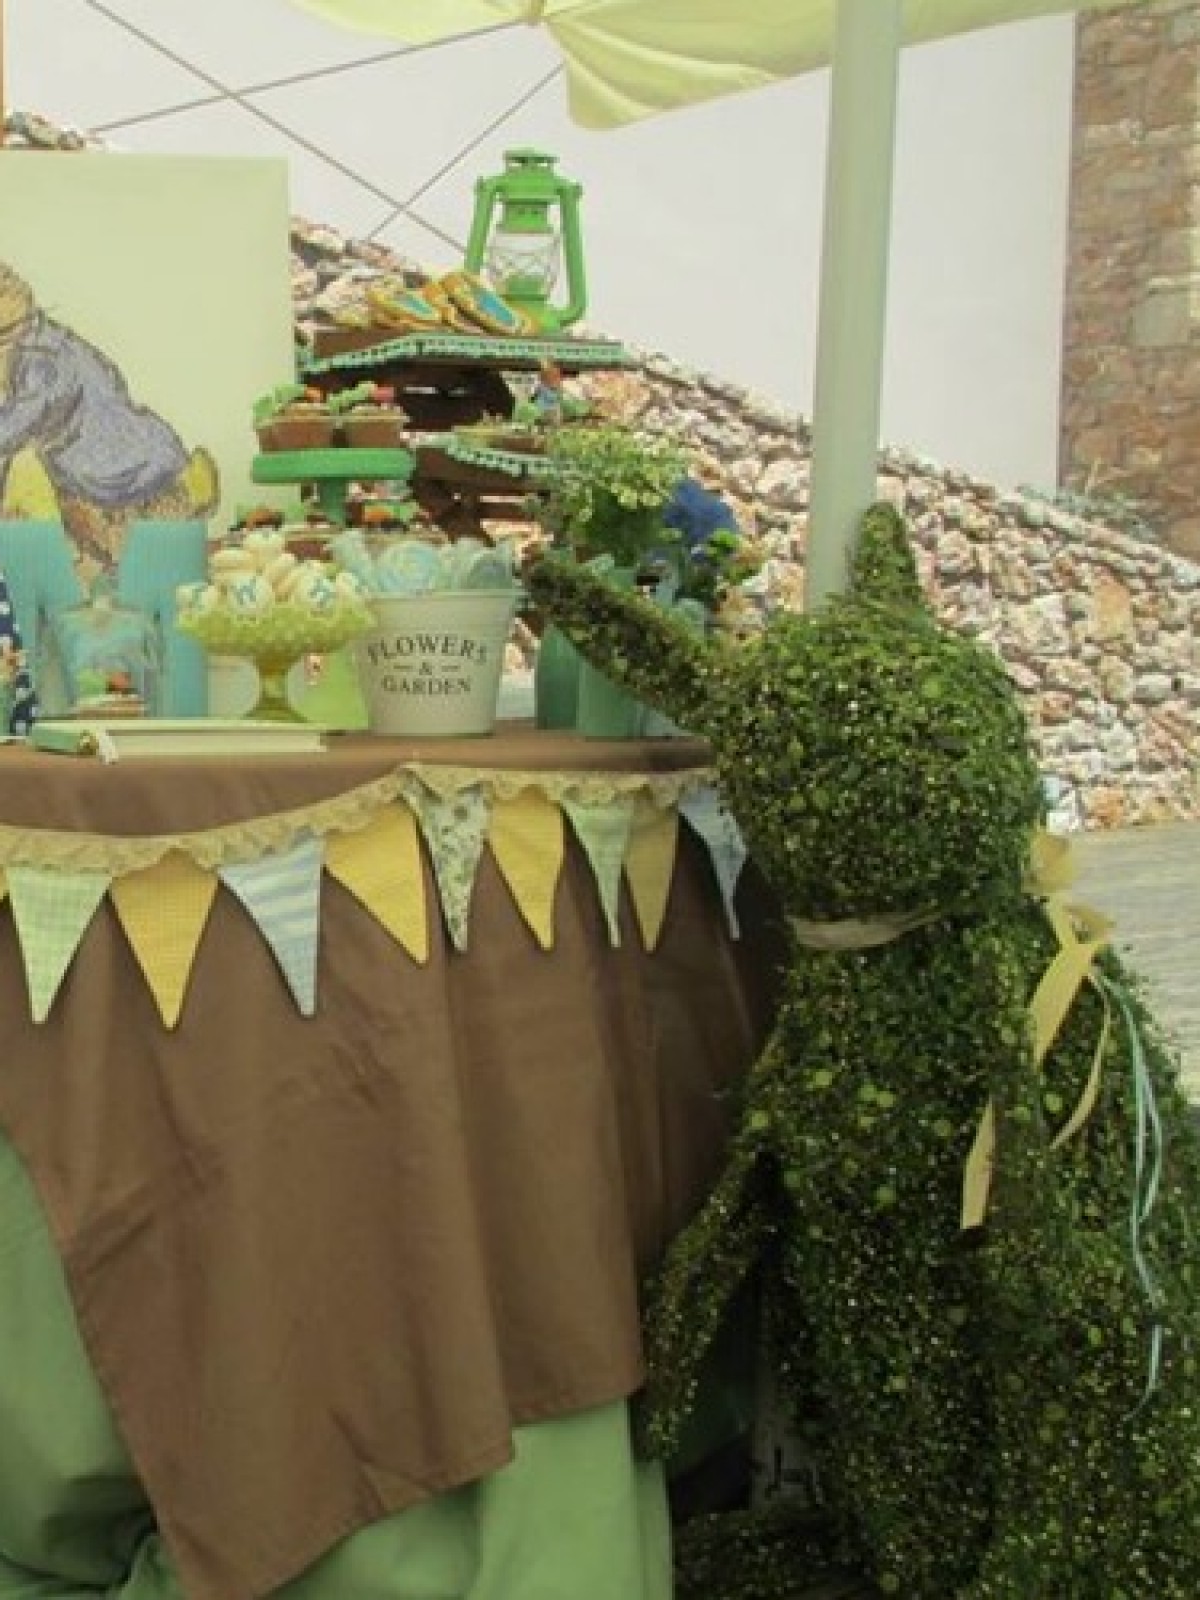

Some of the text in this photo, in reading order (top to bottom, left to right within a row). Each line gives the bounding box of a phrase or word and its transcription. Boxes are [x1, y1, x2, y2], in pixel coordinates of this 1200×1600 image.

[367, 633, 488, 666] FLOWERS
[418, 661, 434, 676] &
[380, 673, 472, 695] GARDEN
